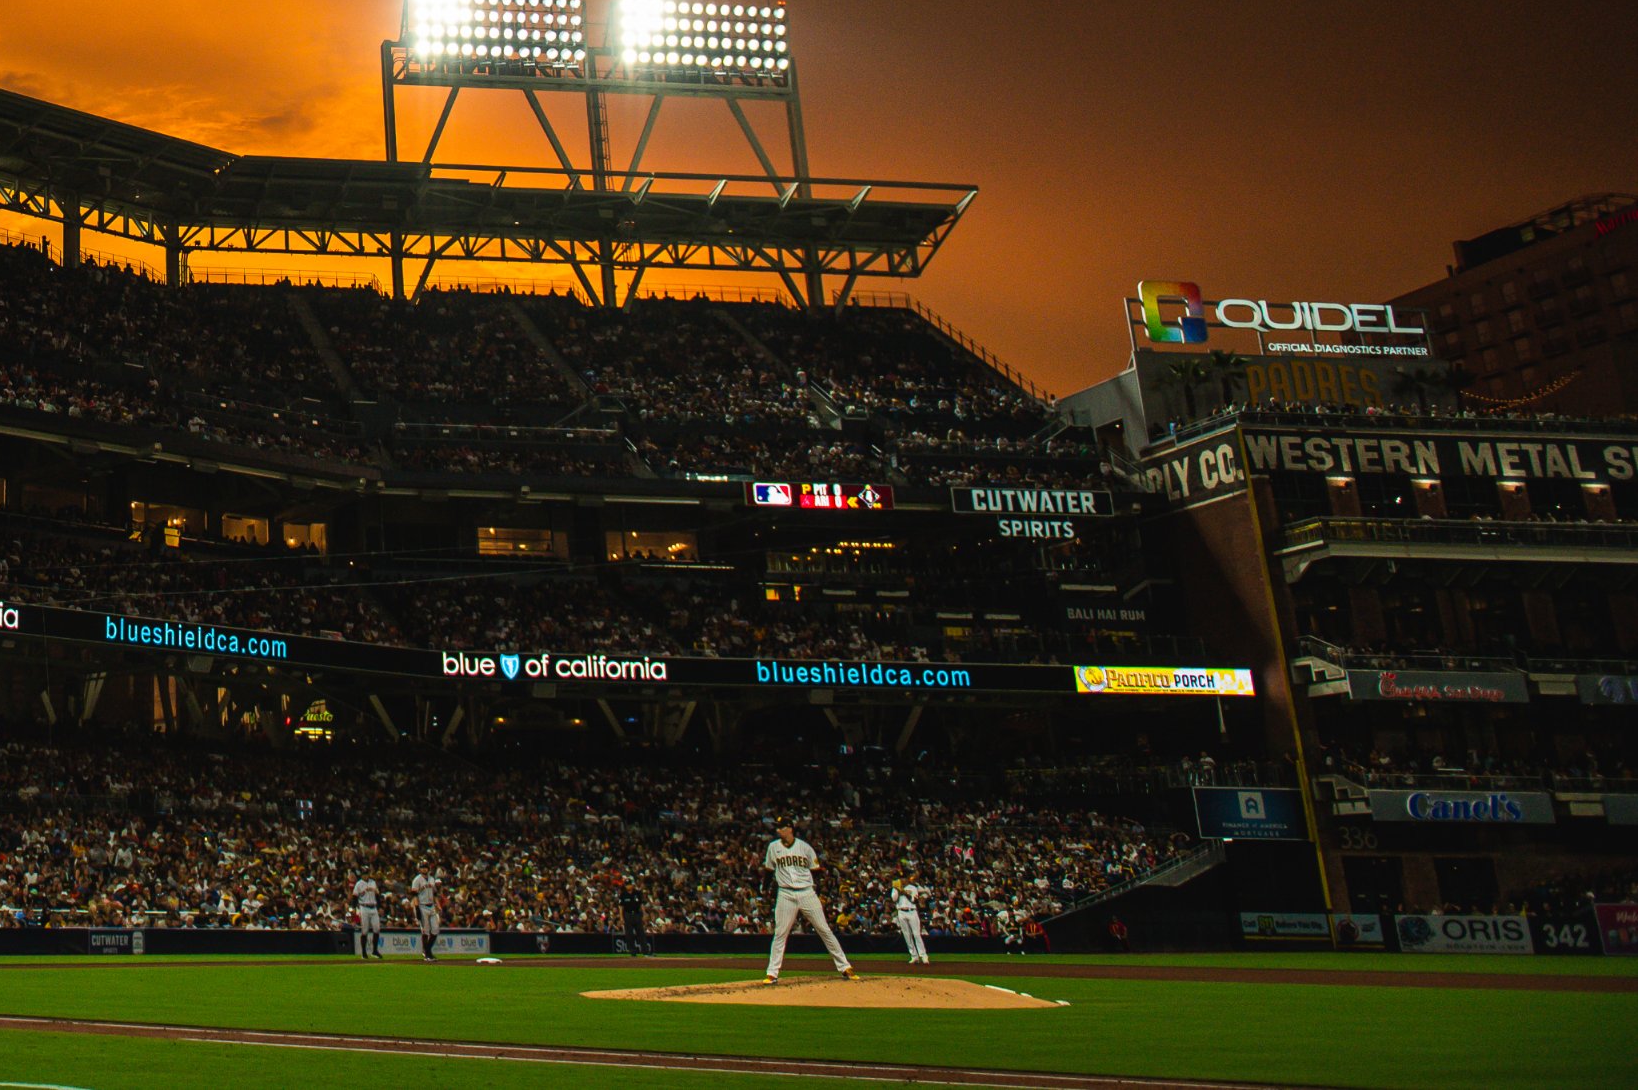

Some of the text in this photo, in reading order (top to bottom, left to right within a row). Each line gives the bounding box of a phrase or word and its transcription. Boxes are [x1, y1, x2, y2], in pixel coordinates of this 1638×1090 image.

[1215, 297, 1424, 335] QUIDEL
[1267, 341, 1429, 357] OFFICIAL DIAGNOSTICS PARTNER
[1247, 359, 1382, 408] PADRES
[1198, 443, 1245, 490] CO.
[1245, 433, 1638, 480] WESTERN METAL S
[971, 488, 1098, 515] CUTWATER
[997, 519, 1075, 540] SPIRITS
[1067, 607, 1146, 621] BALI HAI RUM
[104, 616, 288, 660] blueshieldca.com
[442, 651, 667, 681] blue of california
[756, 659, 972, 688] blueshieldca.com
[1174, 674, 1215, 688] PORCH
[1406, 792, 1523, 822] Canel's
[1338, 826, 1378, 850] 336
[776, 854, 810, 868] PADRES
[91, 933, 129, 946] CUTWATER
[392, 936, 409, 947] blue
[461, 936, 477, 947] blue
[1442, 919, 1524, 941] ORIS
[1542, 923, 1590, 949] 342
